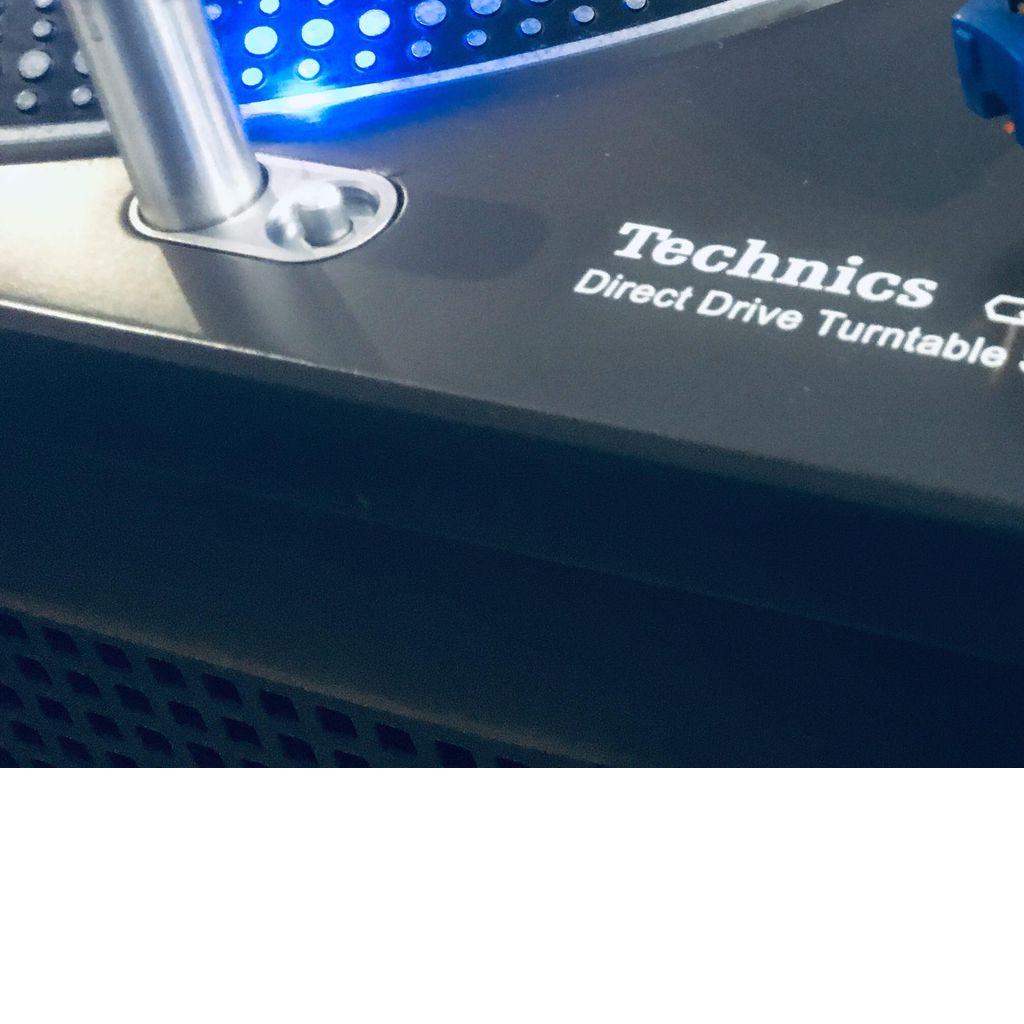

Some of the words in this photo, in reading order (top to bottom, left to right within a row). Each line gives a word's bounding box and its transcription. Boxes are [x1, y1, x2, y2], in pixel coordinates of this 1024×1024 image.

[613, 221, 939, 310] Technics
[573, 267, 694, 312] Direct
[695, 289, 804, 332] Drive
[817, 308, 1009, 370] Turntable
